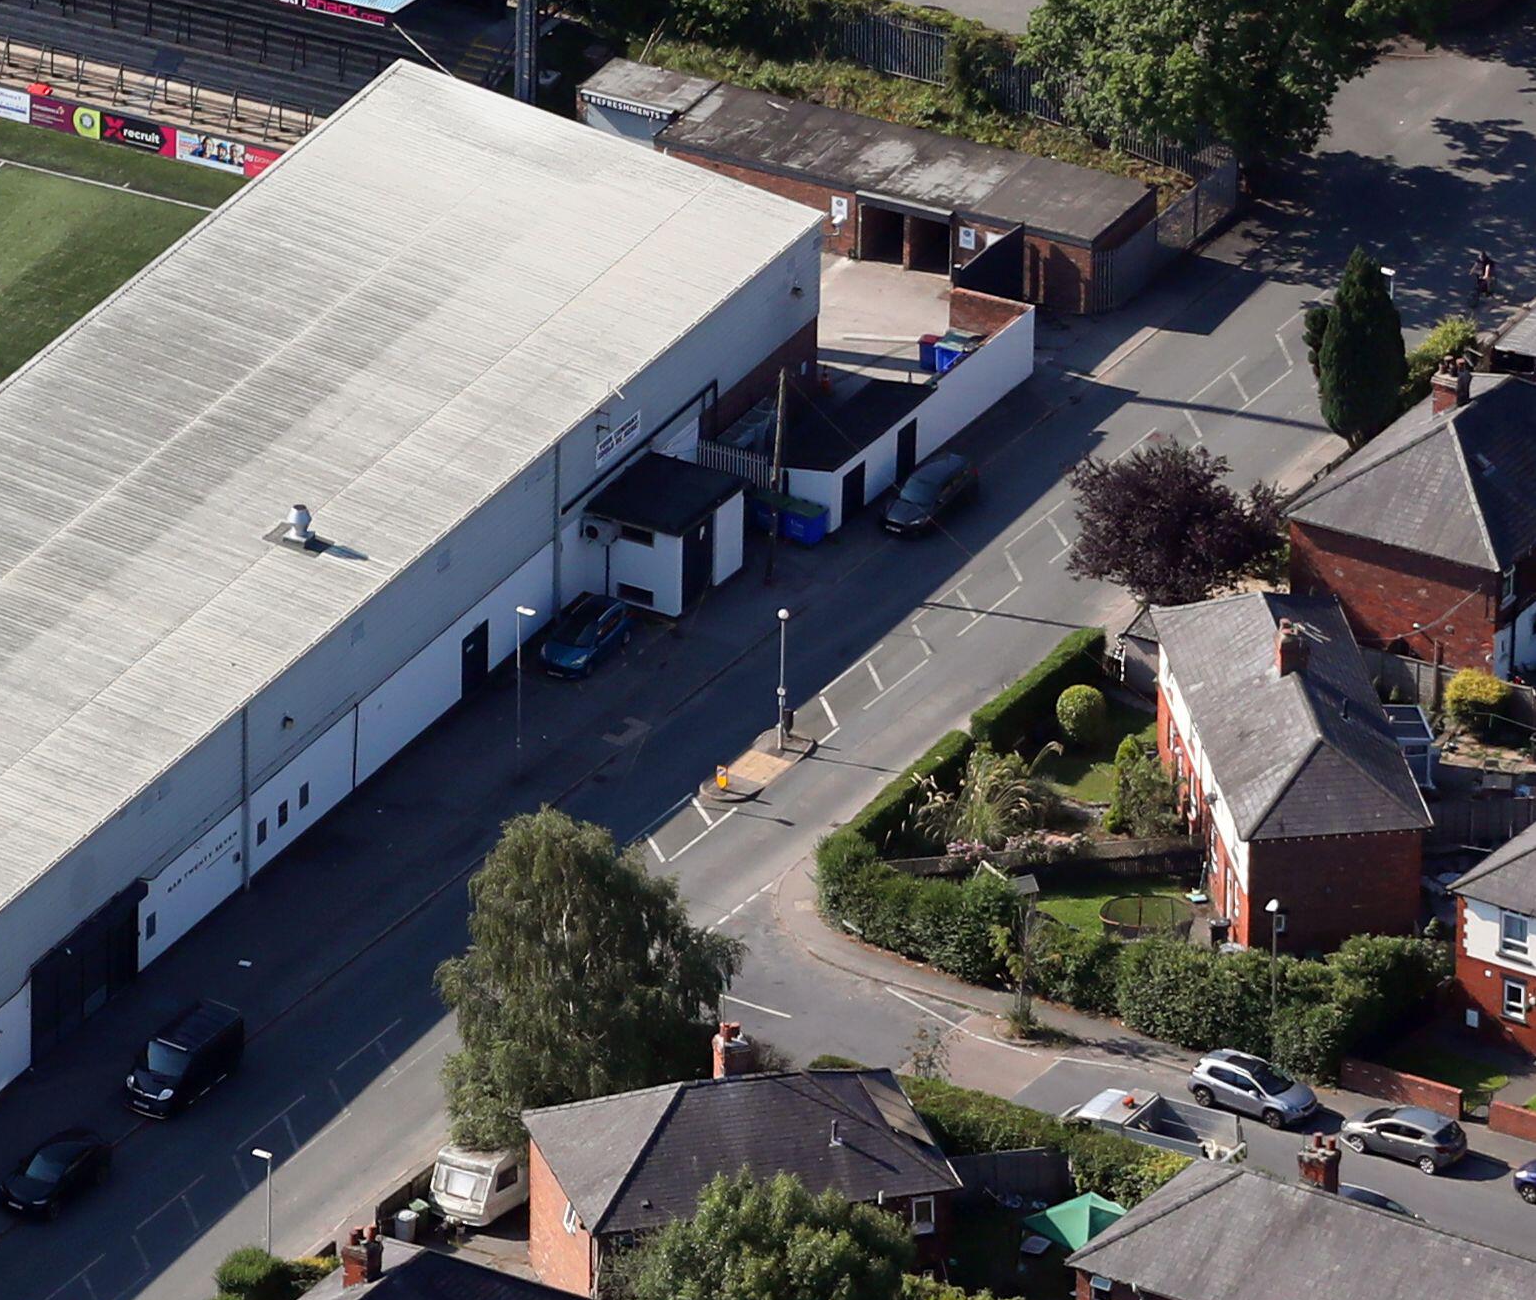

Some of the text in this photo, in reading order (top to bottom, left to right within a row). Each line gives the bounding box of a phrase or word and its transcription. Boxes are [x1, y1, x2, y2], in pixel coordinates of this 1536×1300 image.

[591, 97, 661, 119] REFRESHMENTS
[123, 127, 160, 144] recruit
[167, 830, 238, 894] BAR TWENTY SEVEN
